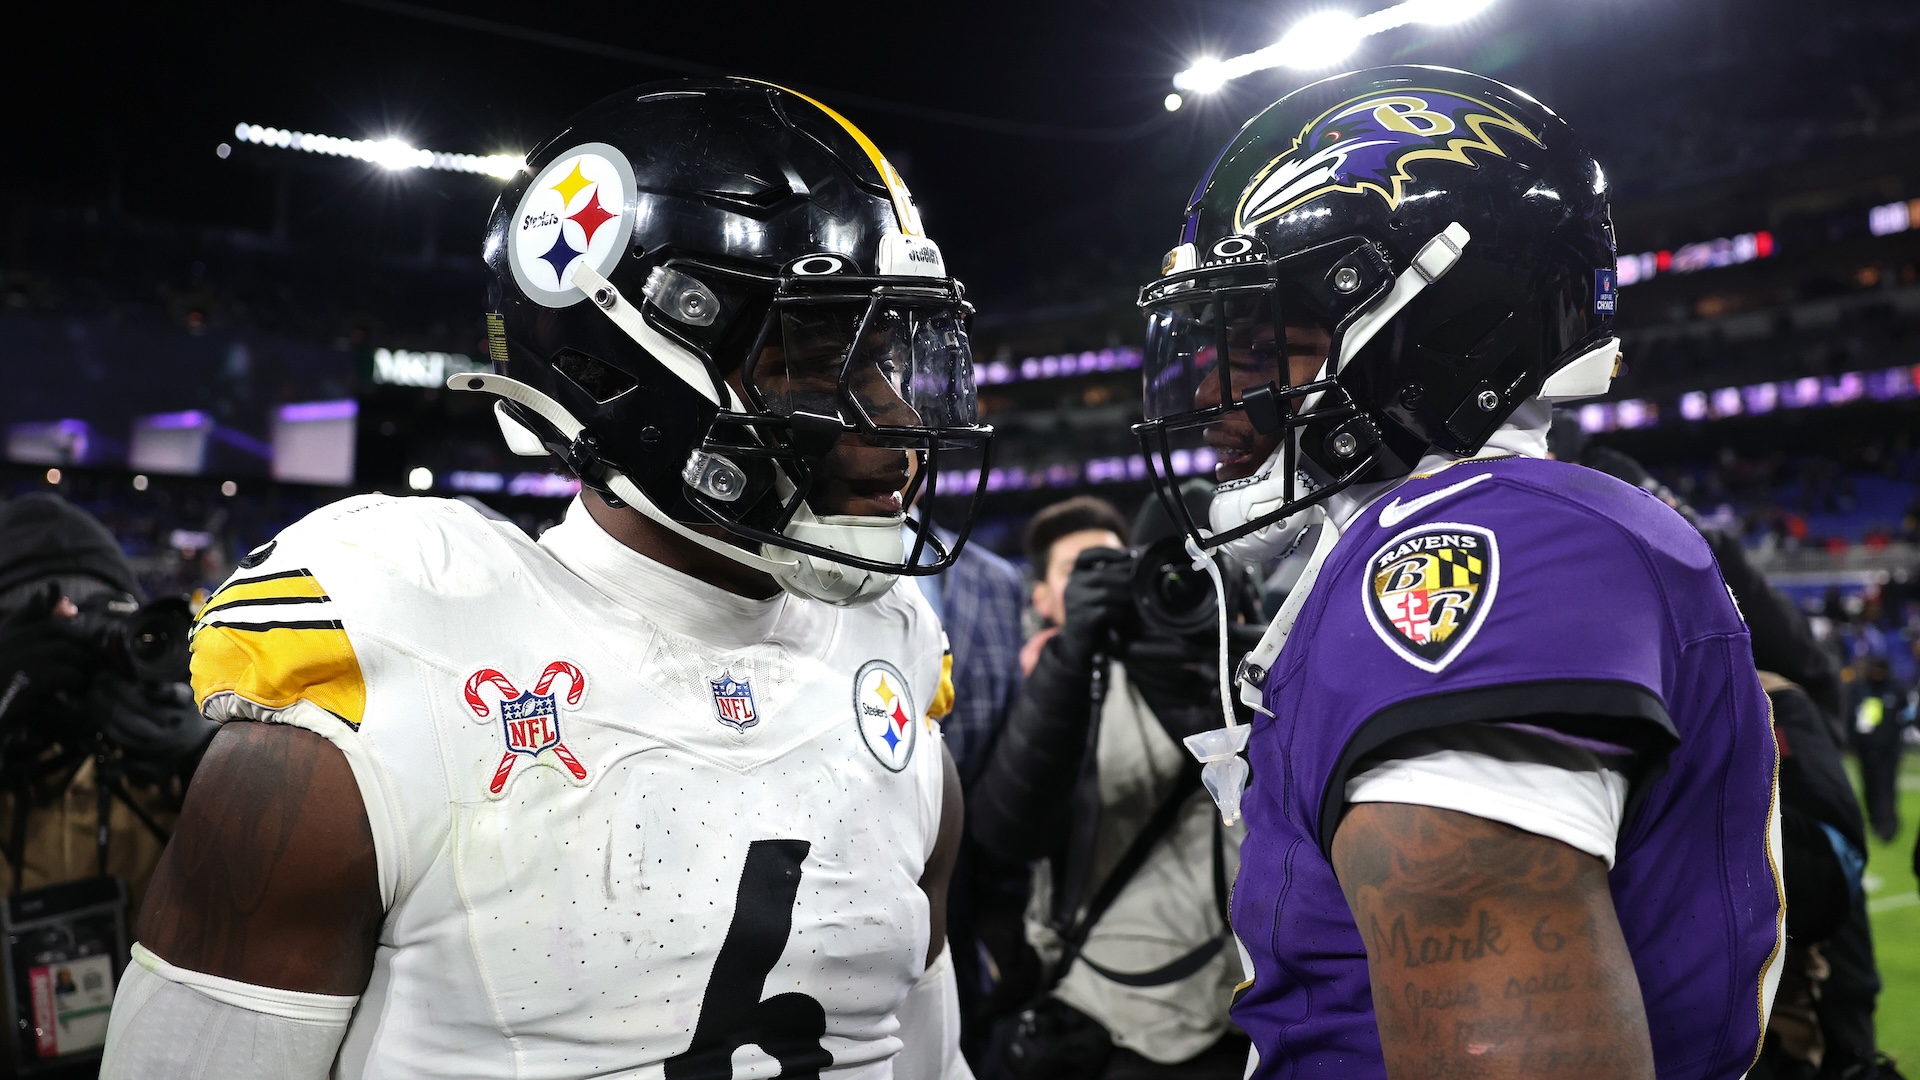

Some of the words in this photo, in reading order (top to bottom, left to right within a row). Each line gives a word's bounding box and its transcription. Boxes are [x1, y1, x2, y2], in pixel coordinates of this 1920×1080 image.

[1362, 96, 1456, 137] B
[1205, 252, 1267, 268] OAKLEY
[1378, 534, 1478, 568] RAVENS
[1376, 555, 1431, 596] B
[1426, 588, 1475, 629] R
[718, 698, 753, 721] NFL
[862, 702, 888, 719] Steelers
[509, 717, 556, 749] NFL
[1369, 908, 1510, 968] Mark
[664, 838, 834, 1080] 6
